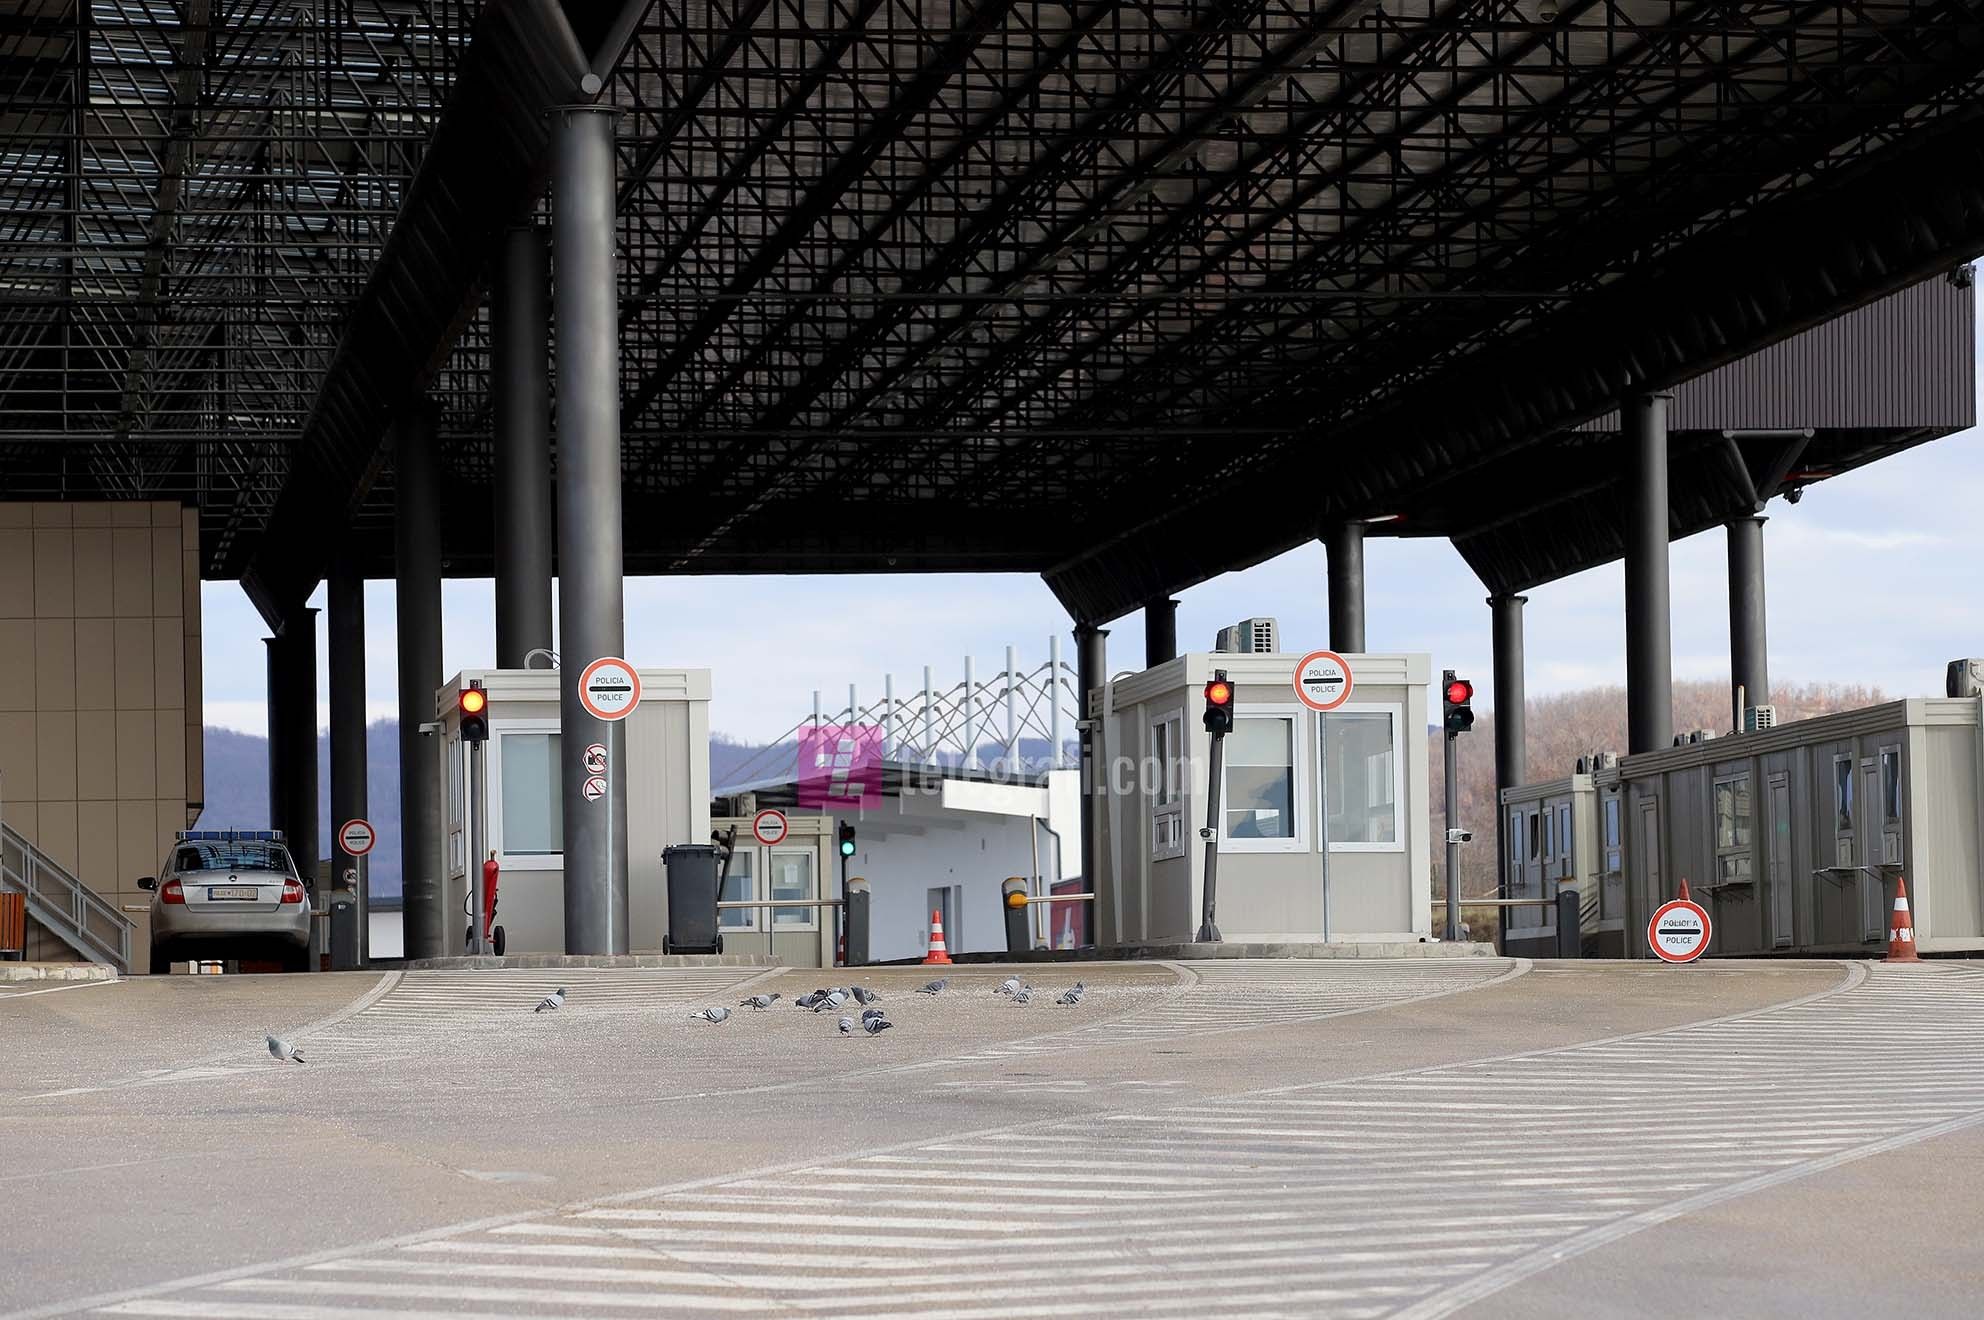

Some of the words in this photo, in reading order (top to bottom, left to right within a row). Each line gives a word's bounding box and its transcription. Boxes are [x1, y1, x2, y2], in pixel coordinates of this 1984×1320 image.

[1308, 669, 1337, 677] POLICIA
[595, 676, 625, 685] POLICIA
[1311, 685, 1336, 693] POLICE
[597, 693, 624, 701] POLICE
[1665, 936, 1693, 944] POLICE
